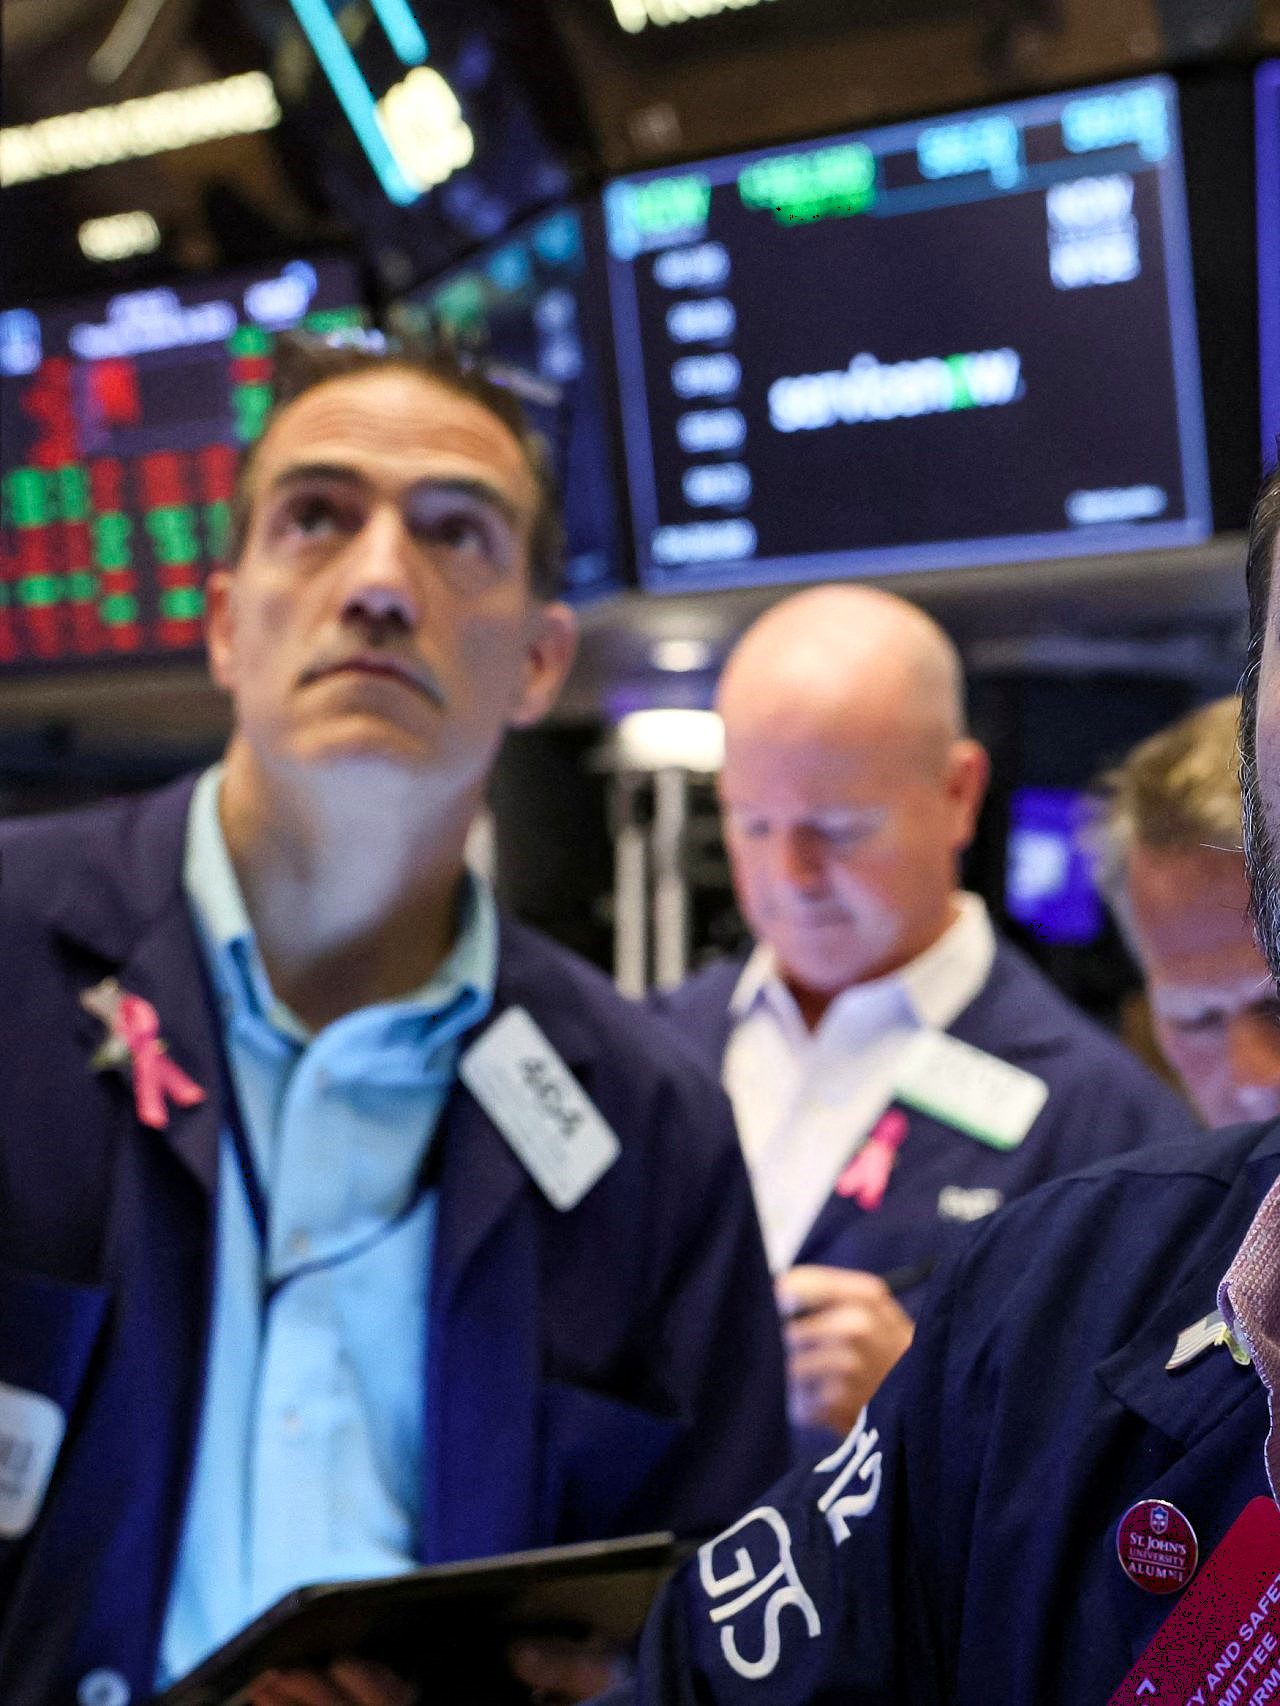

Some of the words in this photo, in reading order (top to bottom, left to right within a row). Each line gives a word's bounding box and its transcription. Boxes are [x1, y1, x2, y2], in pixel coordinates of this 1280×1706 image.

[1128, 1561, 1184, 1582] ALUMNI
[1129, 1547, 1186, 1567] UNIVERSITY
[697, 1505, 822, 1680] GTS
[1206, 1641, 1241, 1692] AND
